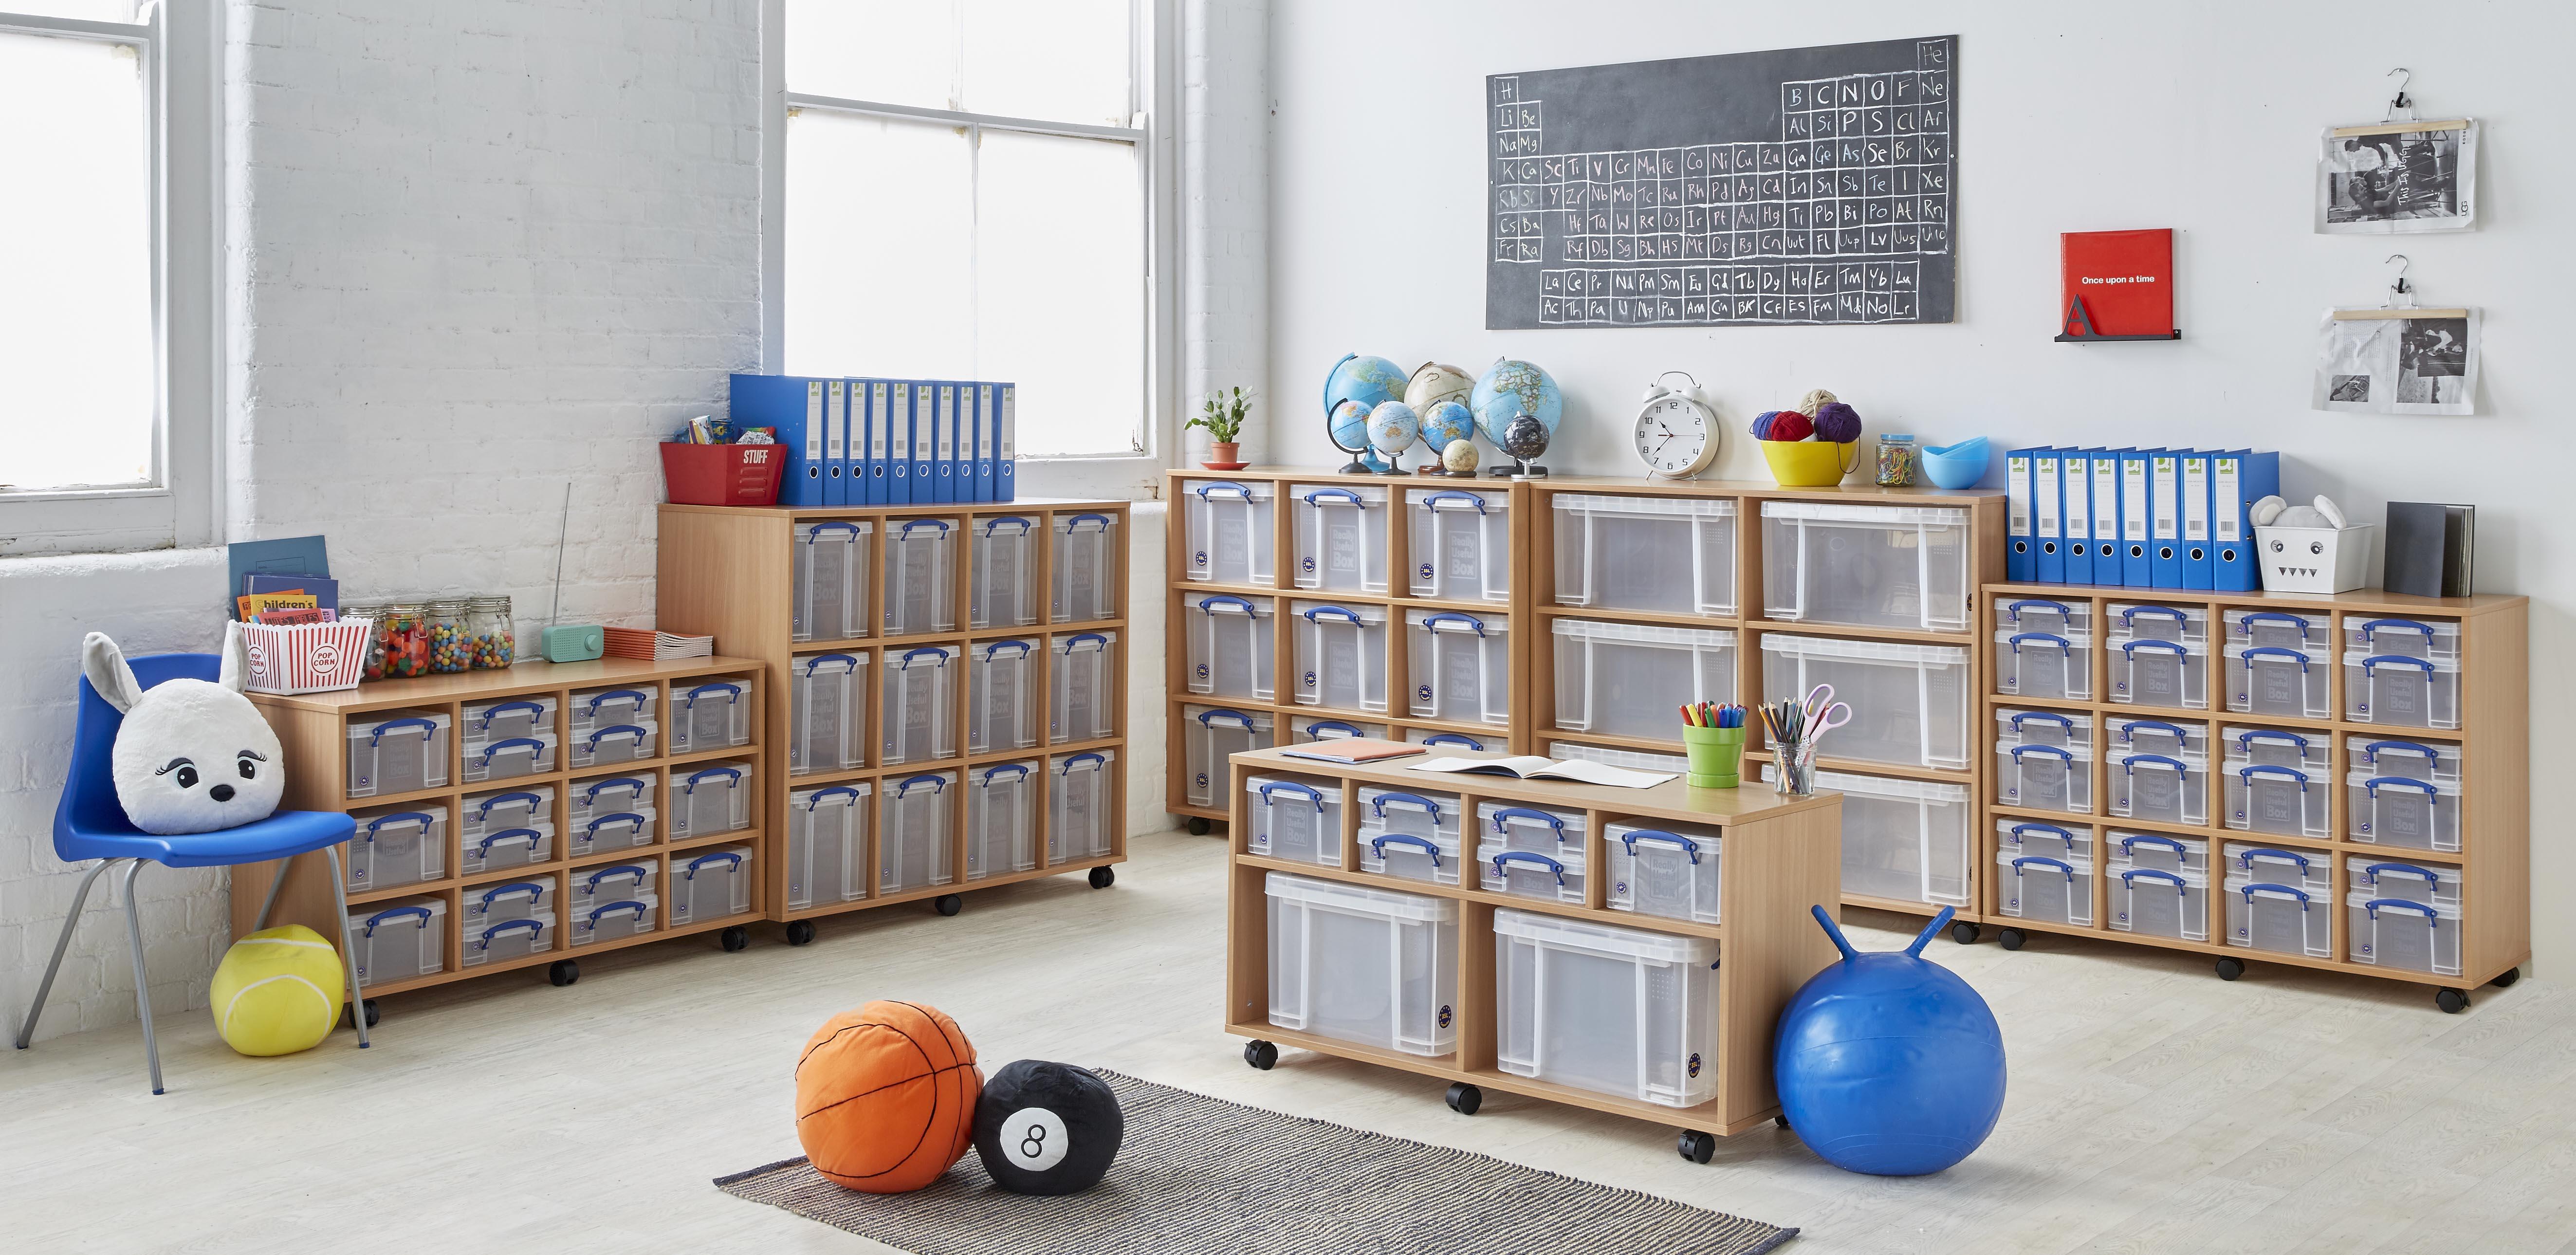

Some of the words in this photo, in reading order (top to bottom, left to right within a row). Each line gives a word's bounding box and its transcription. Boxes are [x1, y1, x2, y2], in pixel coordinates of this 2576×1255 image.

[1501, 82, 1511, 99] H
[1924, 46, 1944, 65] He
[1501, 109, 1512, 127] Li
[1523, 110, 1535, 128] Be
[1790, 89, 1801, 106] B
[1818, 86, 1829, 104] C
[1843, 83, 1857, 102] N
[1871, 81, 1884, 100] O
[1898, 78, 1912, 96] F
[1922, 77, 1943, 95] Ne
[1500, 134, 1516, 153] Na
[1521, 136, 1537, 152] Mg
[1790, 117, 1806, 135] Al
[1818, 114, 1831, 131] Si
[1843, 111, 1856, 131] P
[1872, 111, 1882, 131] S
[1925, 111, 1942, 127] Ar
[1503, 162, 1515, 181] K
[1522, 163, 1536, 179] Ca
[1545, 160, 1562, 179] Sc
[1568, 158, 1579, 175] Ti
[1594, 161, 1602, 176] V
[1615, 159, 1630, 174] Cr
[1638, 156, 1655, 174] Mn
[1663, 158, 1674, 174] Fe
[1687, 152, 1702, 169] Co
[1712, 152, 1727, 169] Ni
[1736, 150, 1752, 168] Cu
[1788, 148, 1806, 167] Ga
[1843, 145, 1859, 165] As
[1869, 144, 1887, 162] Se
[1896, 142, 1912, 160] Br
[1924, 138, 1940, 159] Kr
[2397, 174, 2409, 185] Is
[1550, 187, 1558, 205] Y
[1566, 188, 1585, 204] Zr
[1592, 185, 1607, 201] Nb
[1614, 188, 1633, 203] Mo
[1662, 187, 1677, 203] Ru
[1688, 184, 1704, 200] Rh
[1712, 182, 1729, 200] Pd
[1739, 179, 1753, 200] Ag
[1763, 180, 1780, 194] Cd
[1791, 178, 1806, 194] In
[1818, 178, 1832, 194] Sn
[1843, 176, 1858, 190] Sb
[1869, 175, 1885, 191] Te
[1922, 170, 1943, 188] Xe
[2397, 187, 2409, 206] This
[1500, 218, 1515, 232] Cs
[1523, 217, 1540, 232] Ba
[1569, 216, 1582, 231] Hf
[1590, 215, 1606, 229] Ta
[1617, 215, 1628, 229] W
[1664, 213, 1679, 227] Os
[1737, 210, 1754, 228] Au
[1765, 206, 1780, 226] Hg
[1816, 205, 1833, 222] Pb
[1844, 206, 1856, 220] Bi
[1871, 204, 1887, 219] Po
[1896, 203, 1912, 220] At
[1925, 200, 1942, 218] Rn
[1500, 241, 1514, 256] Fr
[1522, 243, 1537, 258] Ra
[1568, 240, 1583, 258] Rf
[1592, 240, 1608, 256] Db
[1618, 240, 1631, 256] Sg
[1640, 241, 1655, 256] Bh
[1712, 237, 1729, 254] Ds
[1763, 236, 1781, 249] Cn
[1818, 235, 1829, 252] Fl
[1546, 276, 1558, 290] La
[1568, 273, 1581, 291] Ce
[1592, 275, 1601, 290] Pr
[1661, 275, 1679, 290] Sm
[1689, 275, 1701, 291] Eu
[1711, 273, 1728, 291] Gd
[1735, 273, 1754, 289] Tb
[1764, 274, 1780, 290] Dy
[1815, 271, 1830, 288] Er
[1870, 268, 1887, 286] Yb
[2106, 276, 2127, 285] upon
[1545, 301, 1557, 314] Ac
[1590, 301, 1606, 316] Pa
[1619, 301, 1627, 314] U
[1662, 302, 1674, 316] Pu
[1867, 297, 1888, 314] No
[743, 450, 768, 463] STUFF
[1333, 530, 1354, 540] Really
[1452, 536, 1474, 548] Really
[1333, 541, 1354, 551] Useful
[1452, 547, 1473, 558] Useful
[1333, 553, 1354, 568] Box
[1452, 559, 1473, 575] Box
[255, 600, 313, 609] Children's
[2267, 670, 2288, 681] Really
[2268, 687, 2288, 700] Box
[1287, 807, 1306, 818] Really
[2266, 807, 2287, 818] Box
[1287, 818, 1305, 828] Useful
[1287, 828, 1305, 843] Box
[1021, 1124, 1046, 1158] 8
